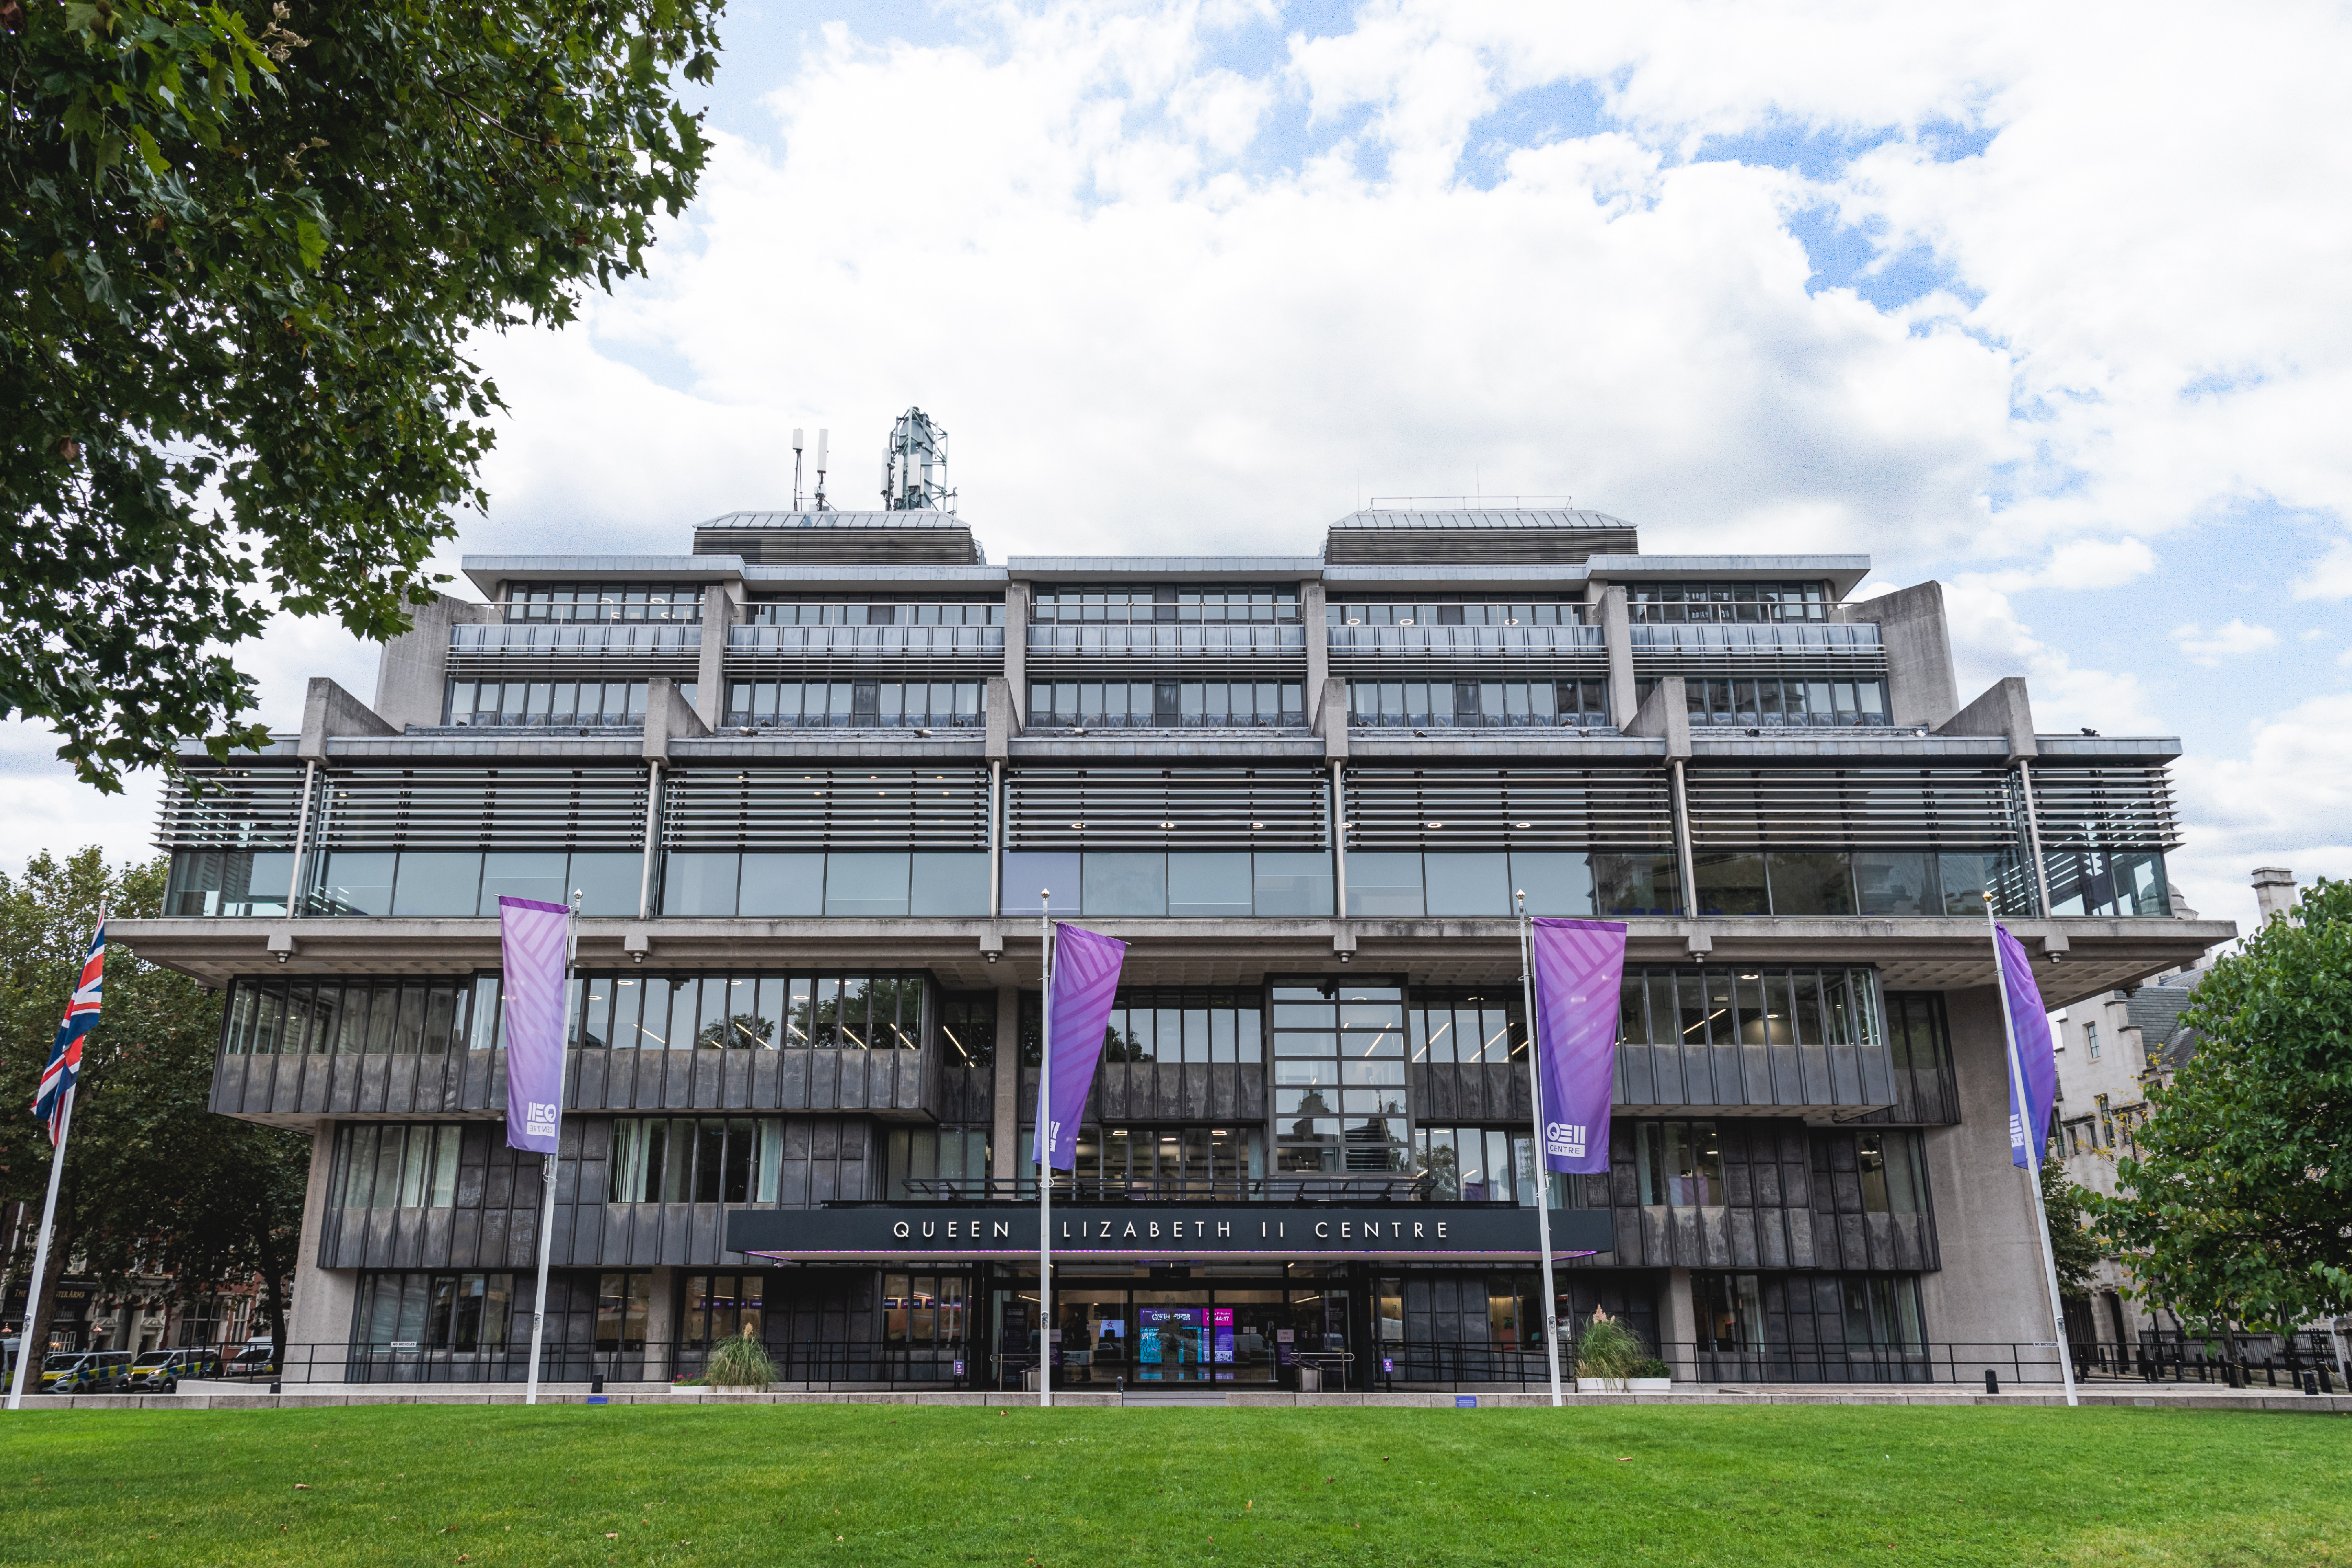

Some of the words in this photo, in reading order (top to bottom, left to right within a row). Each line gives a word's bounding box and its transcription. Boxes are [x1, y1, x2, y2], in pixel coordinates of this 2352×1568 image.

[1547, 1122, 1586, 1144] QEII
[1550, 1145, 1580, 1155] CENTRE
[893, 1221, 1009, 1238] QUEEN
[1064, 1221, 1230, 1238] LIZABETH
[1262, 1221, 1284, 1238] II
[1315, 1221, 1447, 1238] CENTRE
[15, 1289, 27, 1297] THE
[68, 1290, 85, 1299] ARMS
